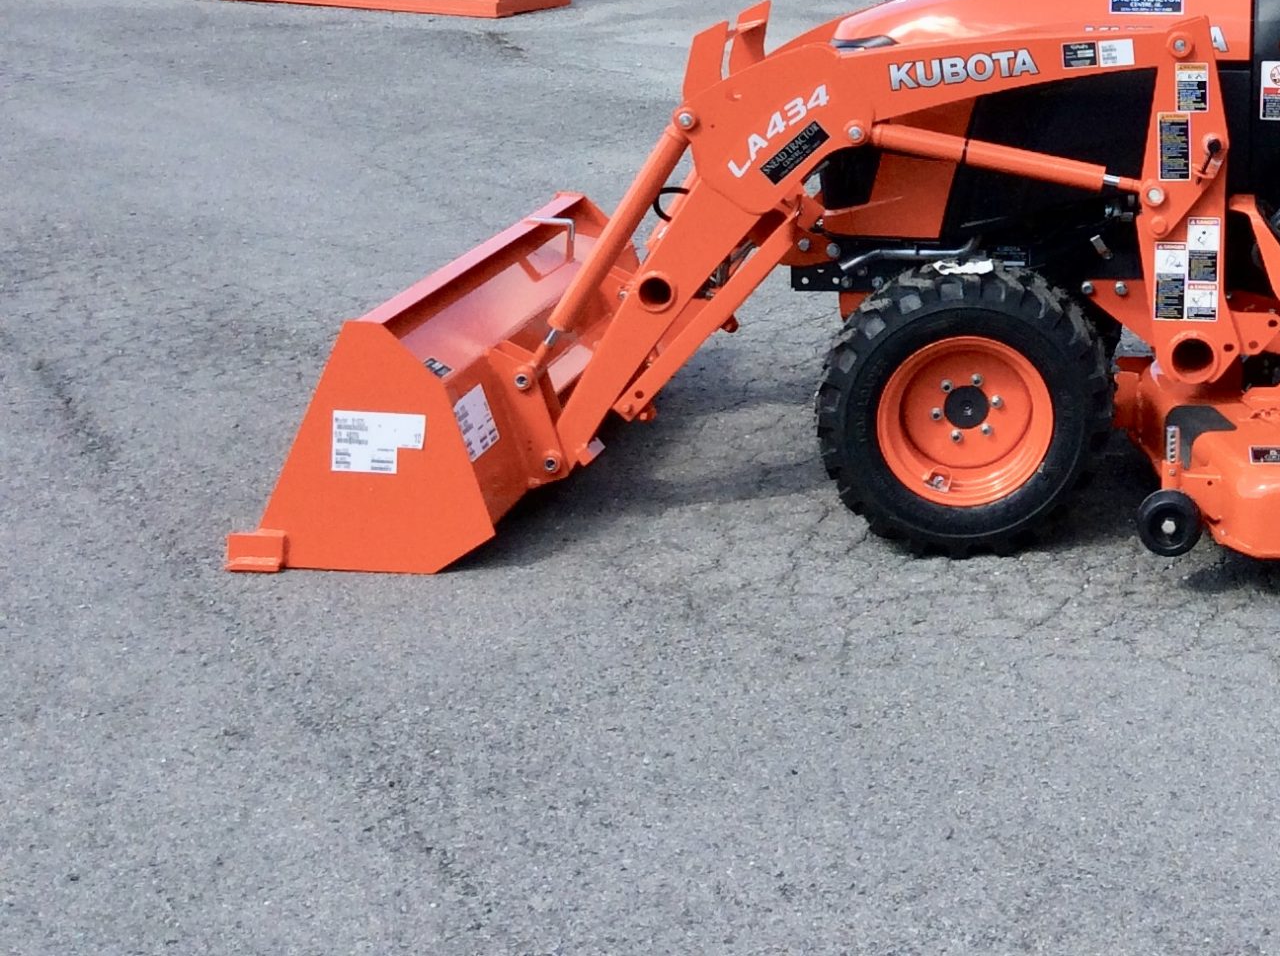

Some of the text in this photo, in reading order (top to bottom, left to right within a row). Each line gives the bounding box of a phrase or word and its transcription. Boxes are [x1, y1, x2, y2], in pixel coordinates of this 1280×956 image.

[888, 48, 1040, 91] KUBOTA
[727, 84, 830, 178] LA434
[762, 151, 788, 174] SNEAD
[788, 123, 820, 154] TRACTOR
